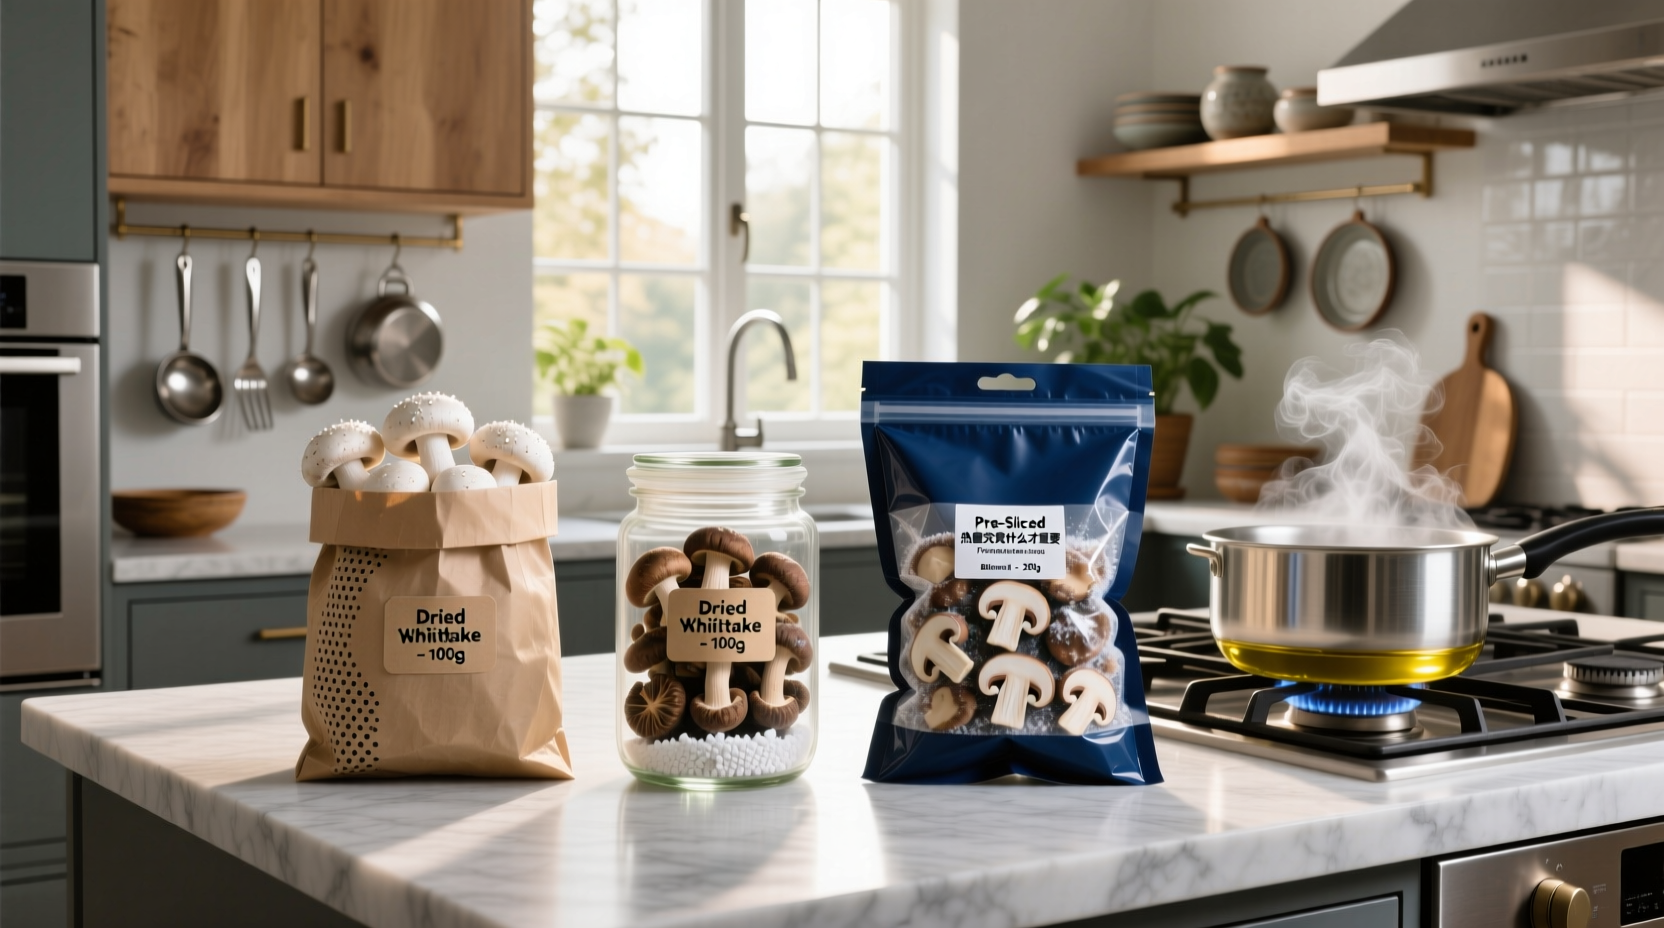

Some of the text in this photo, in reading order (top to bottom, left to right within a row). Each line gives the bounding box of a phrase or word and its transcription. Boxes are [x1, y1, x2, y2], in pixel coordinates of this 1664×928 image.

[416, 607, 466, 625] Dried
[699, 599, 747, 616] Dried
[711, 636, 746, 654] 100g
[428, 646, 466, 665] 100g
